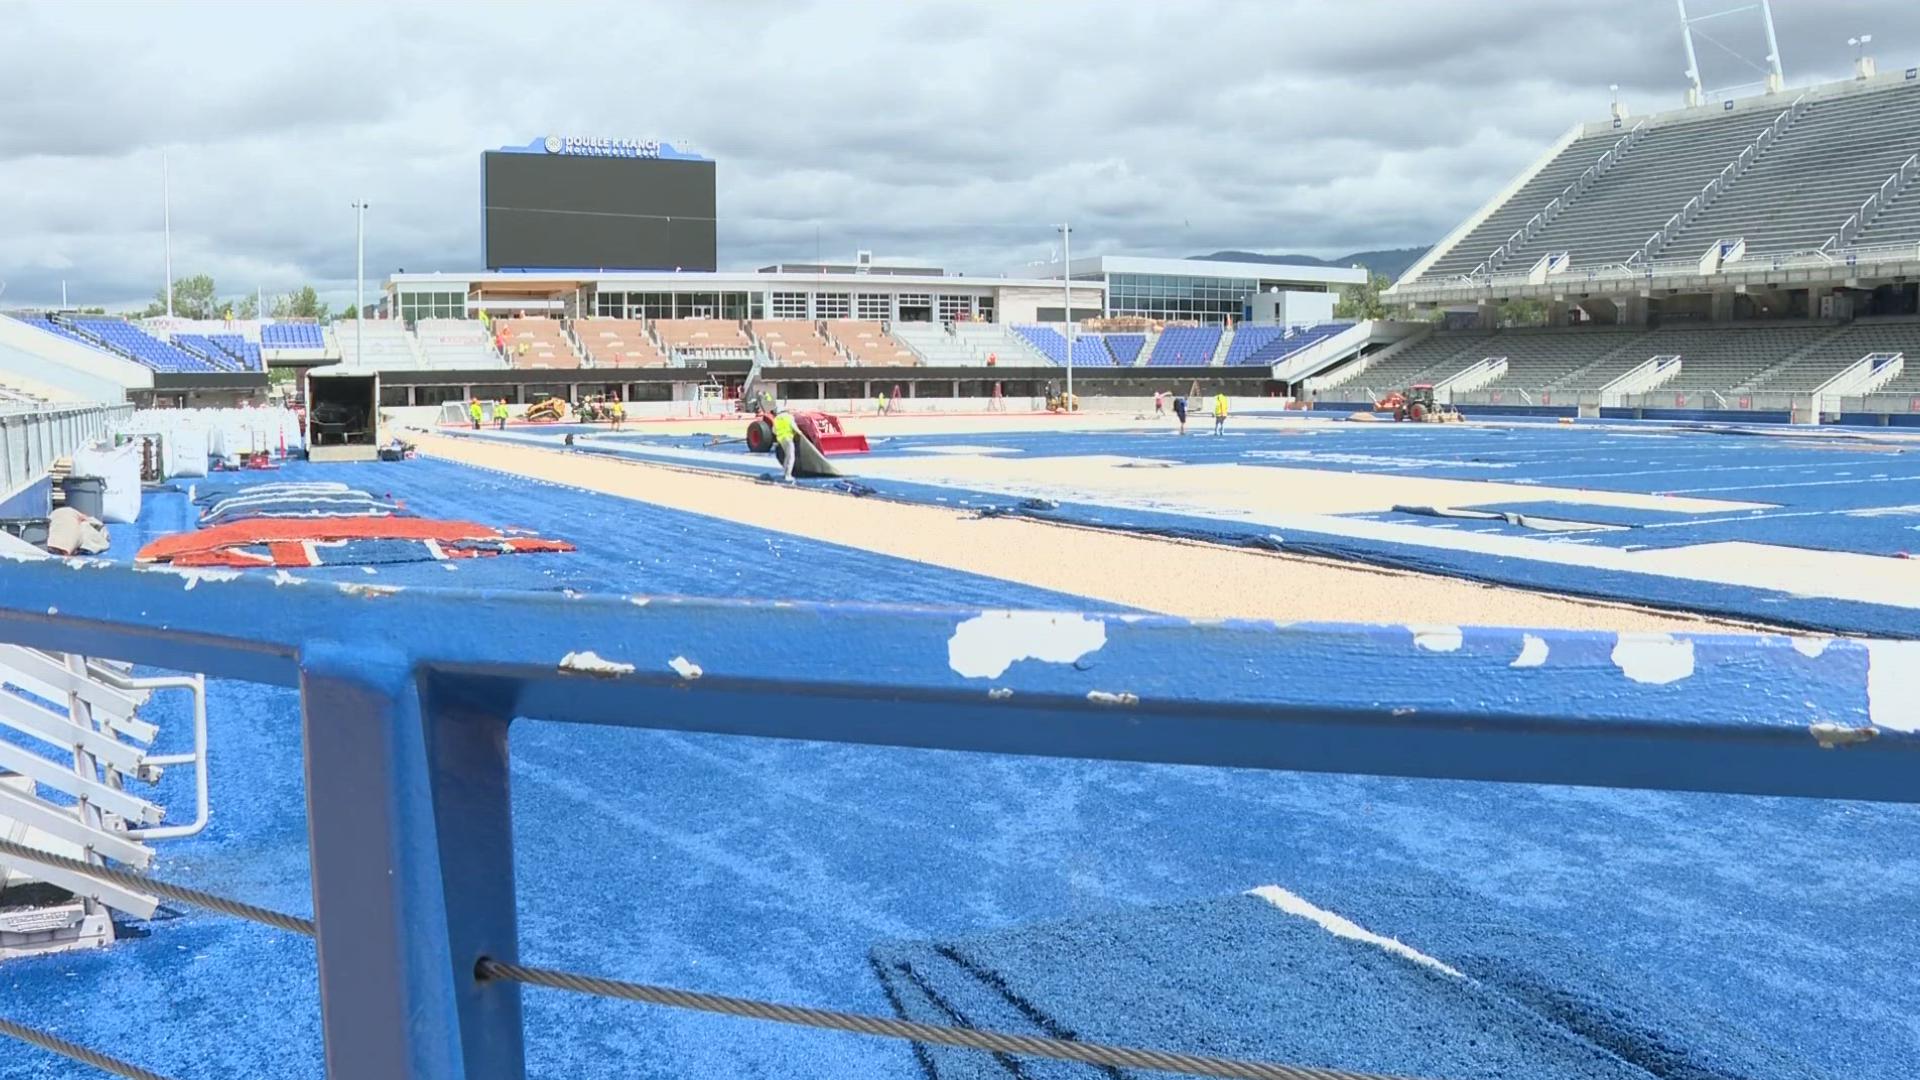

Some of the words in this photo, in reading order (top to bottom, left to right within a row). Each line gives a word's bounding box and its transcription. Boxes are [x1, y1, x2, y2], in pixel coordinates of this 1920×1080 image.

[565, 136, 609, 147] DOUBLE
[623, 138, 660, 149] RANCH
[565, 146, 630, 154] Northwest
[635, 148, 660, 156] Beef
